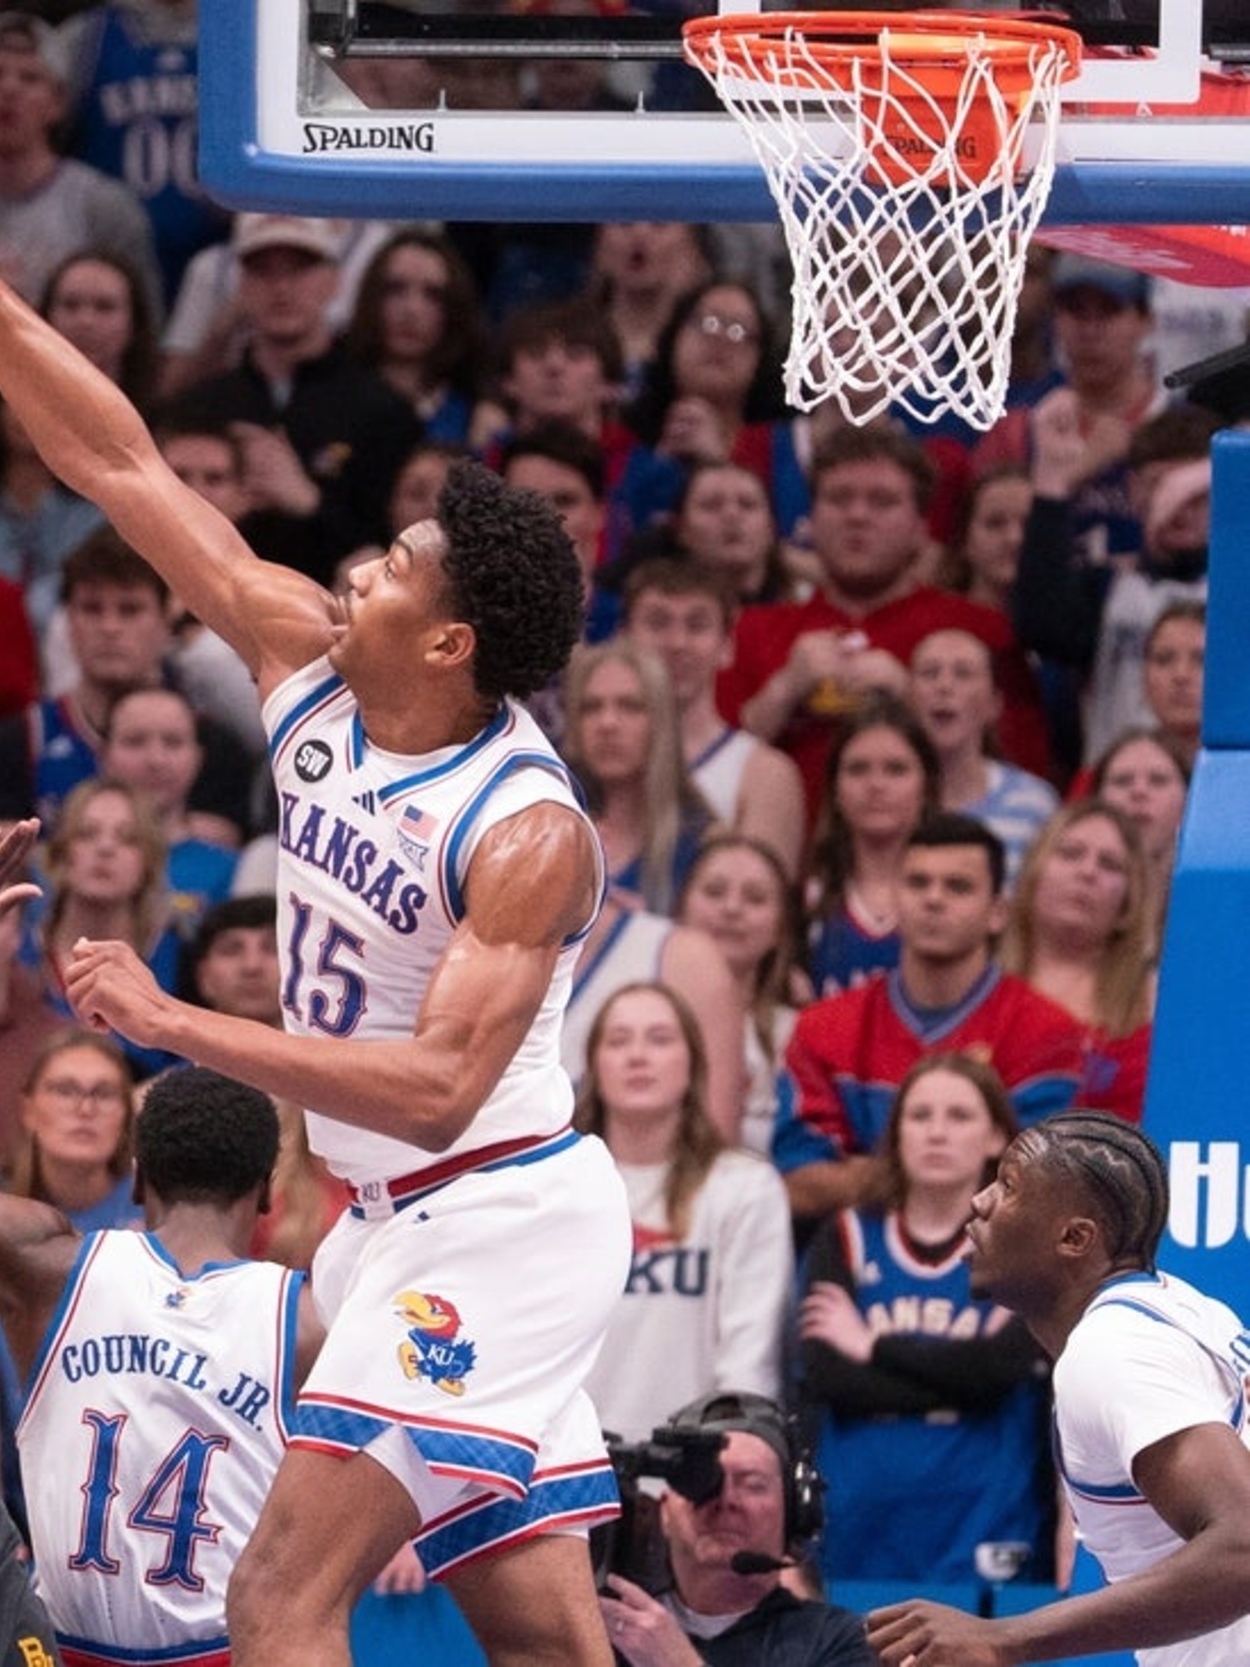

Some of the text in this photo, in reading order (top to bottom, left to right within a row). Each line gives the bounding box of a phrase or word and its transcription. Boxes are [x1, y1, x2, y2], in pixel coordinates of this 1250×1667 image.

[303, 122, 434, 153] SPALDING
[297, 745, 331, 777] SW
[280, 792, 428, 935] KANSAS
[282, 891, 368, 1038] 15
[361, 1181, 382, 1202] KU
[623, 1249, 710, 1296] KU
[427, 1343, 455, 1366] KU
[62, 1334, 271, 1432] COUNCIL JR.
[68, 1408, 231, 1593] 14
